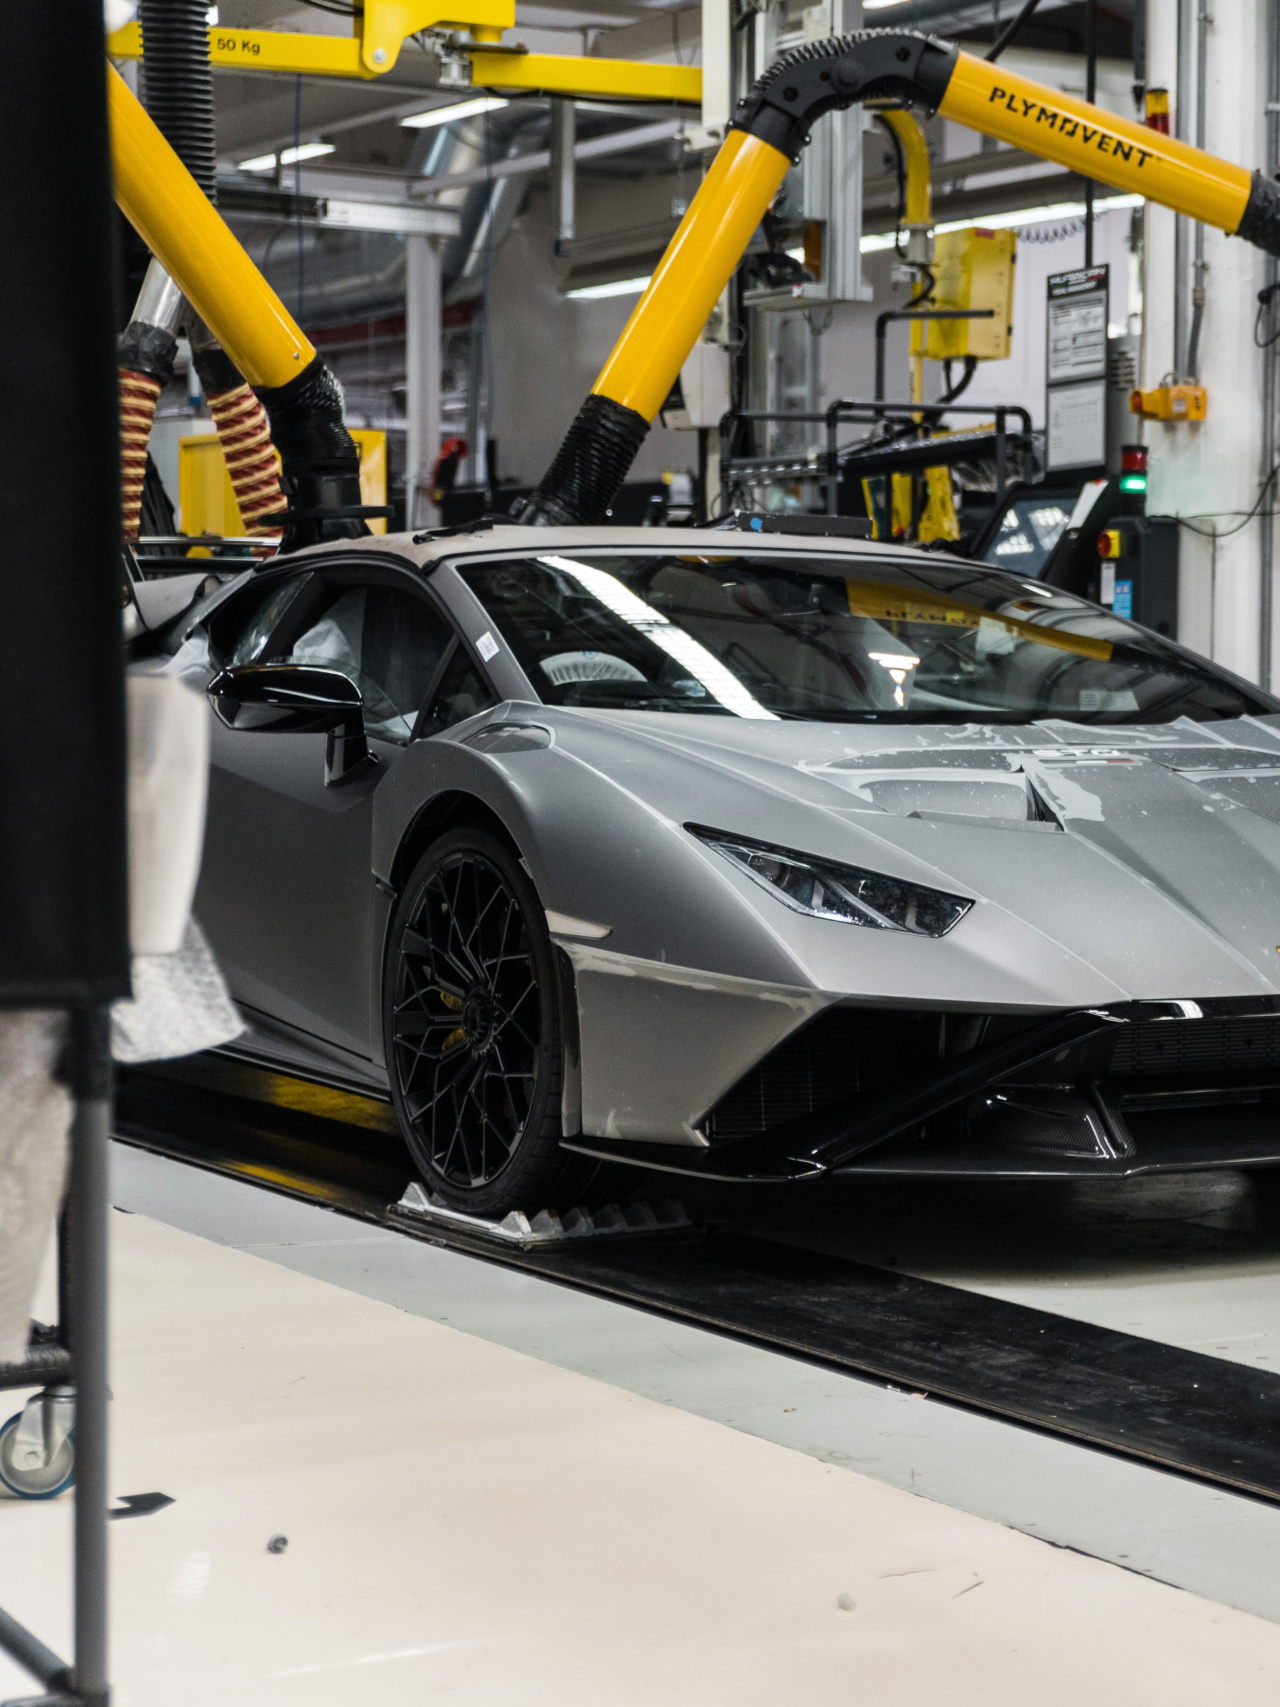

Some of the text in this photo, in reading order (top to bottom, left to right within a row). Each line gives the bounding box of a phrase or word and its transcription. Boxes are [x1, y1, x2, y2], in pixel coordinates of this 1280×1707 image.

[216, 38, 260, 56] 50 Kg
[989, 86, 1153, 168] PLYMOVENT
